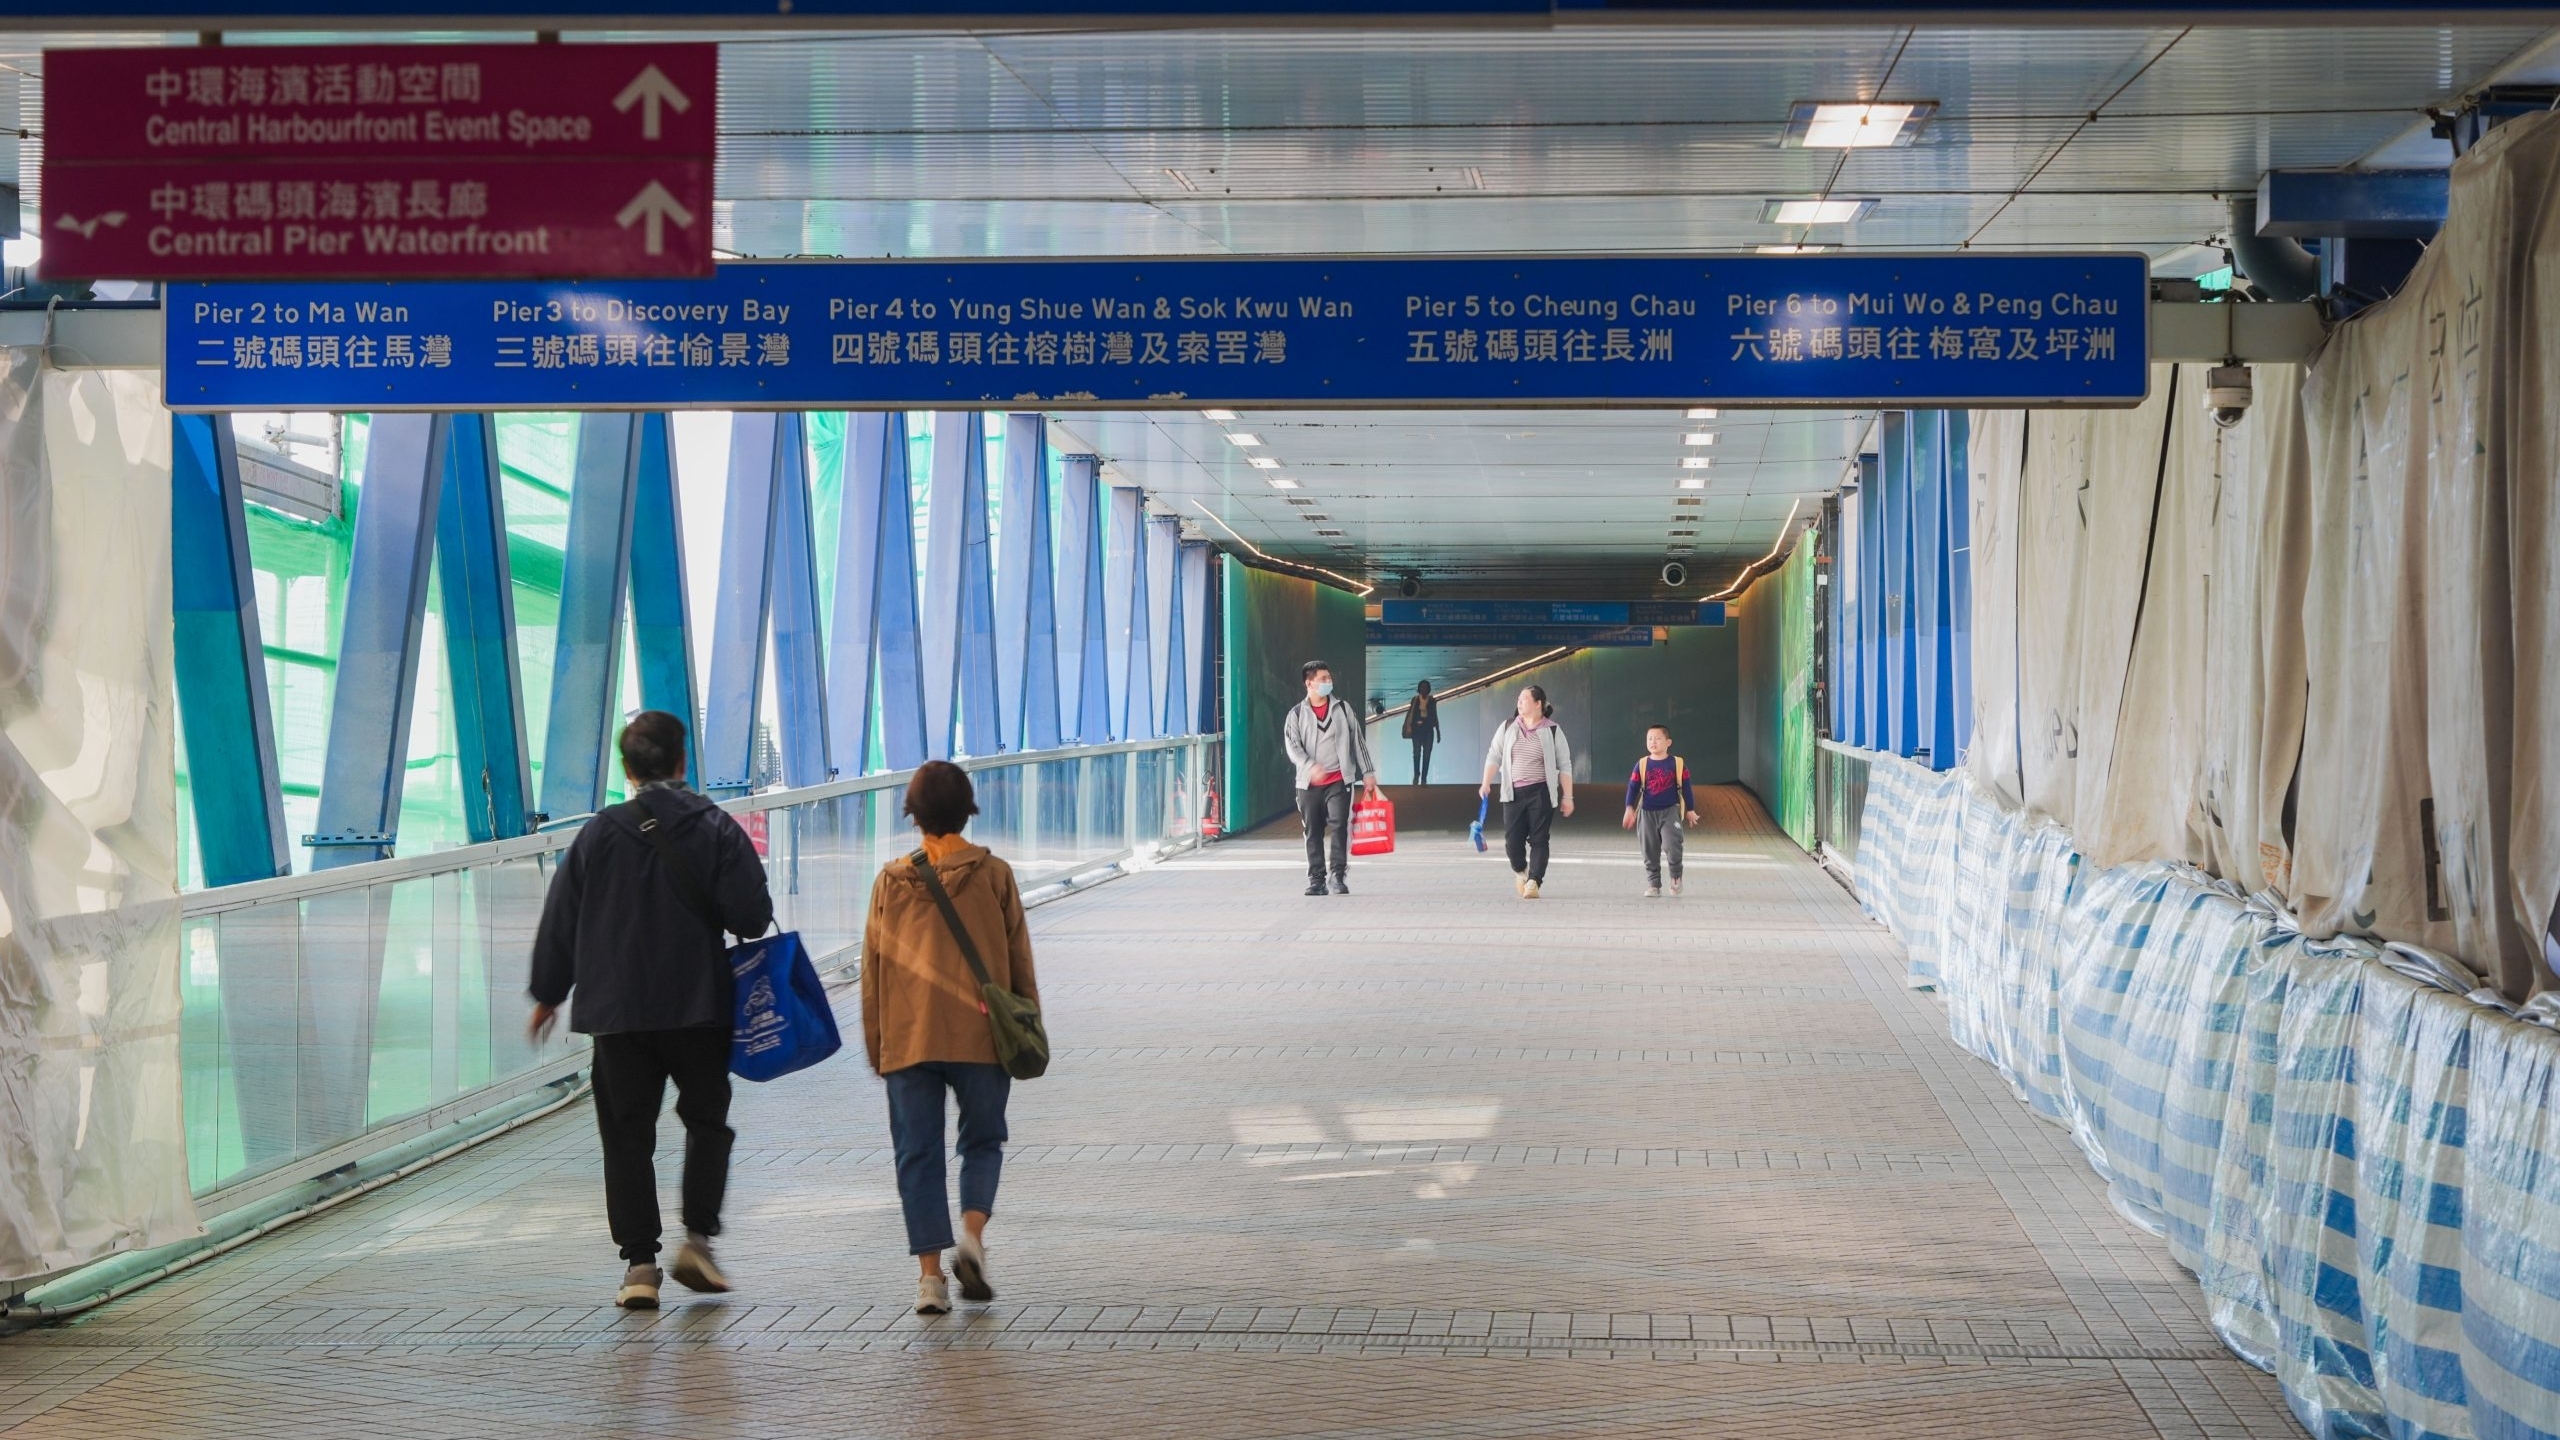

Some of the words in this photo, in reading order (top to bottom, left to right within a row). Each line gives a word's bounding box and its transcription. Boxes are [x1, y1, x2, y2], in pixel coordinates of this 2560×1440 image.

[145, 62, 482, 107] 中環海濱活動空間
[146, 114, 240, 146] Central
[247, 111, 418, 144] Harbourfront
[424, 110, 501, 142] Event
[508, 108, 592, 148] Space
[150, 180, 488, 222] 中環碼頭海濱長廊
[148, 225, 273, 257] Central
[284, 225, 354, 255] Pier
[361, 223, 550, 255] Waterfront
[195, 302, 244, 323] Pier
[251, 303, 266, 323] 2
[274, 302, 300, 323] to
[309, 302, 346, 323] Ma
[355, 301, 409, 323] Wan
[493, 300, 546, 323] Pier
[547, 302, 563, 322] 3
[571, 301, 597, 322] to
[607, 299, 729, 325] Discovery
[743, 299, 791, 325] Bay
[829, 297, 878, 319] Pier
[885, 298, 904, 319] 4
[911, 299, 937, 319] to
[949, 298, 1011, 325] Yung
[1020, 297, 1083, 319] Shue
[1092, 297, 1146, 319] Wan
[1153, 297, 1171, 319] &
[1180, 296, 1227, 319] Sok
[1235, 296, 1289, 318] Kwu
[1298, 296, 1353, 318] Wan
[1406, 295, 1457, 318] Pier
[1464, 296, 1480, 317] 5
[1488, 296, 1516, 317] to
[1523, 294, 1618, 321] Cheung
[1630, 294, 1696, 317] Chau
[1727, 294, 1777, 316] Pier
[1785, 294, 1802, 316] 6
[1809, 294, 1838, 316] to
[1848, 293, 1895, 315] Mui
[1903, 293, 1945, 315] Wo
[1952, 293, 1971, 315] &
[1979, 293, 2042, 320] Peng
[2051, 293, 2118, 315] Chau
[196, 335, 453, 369] 二號碼頭往馬灣
[494, 332, 791, 369] 三號碼頭往愉景灣
[832, 331, 1287, 366] 四號碼頭往榕樹灣及索罟灣
[1406, 328, 1673, 363] 五號碼頭往長洲
[1730, 326, 2117, 362] 六號碼頭往梅窩及坪洲
